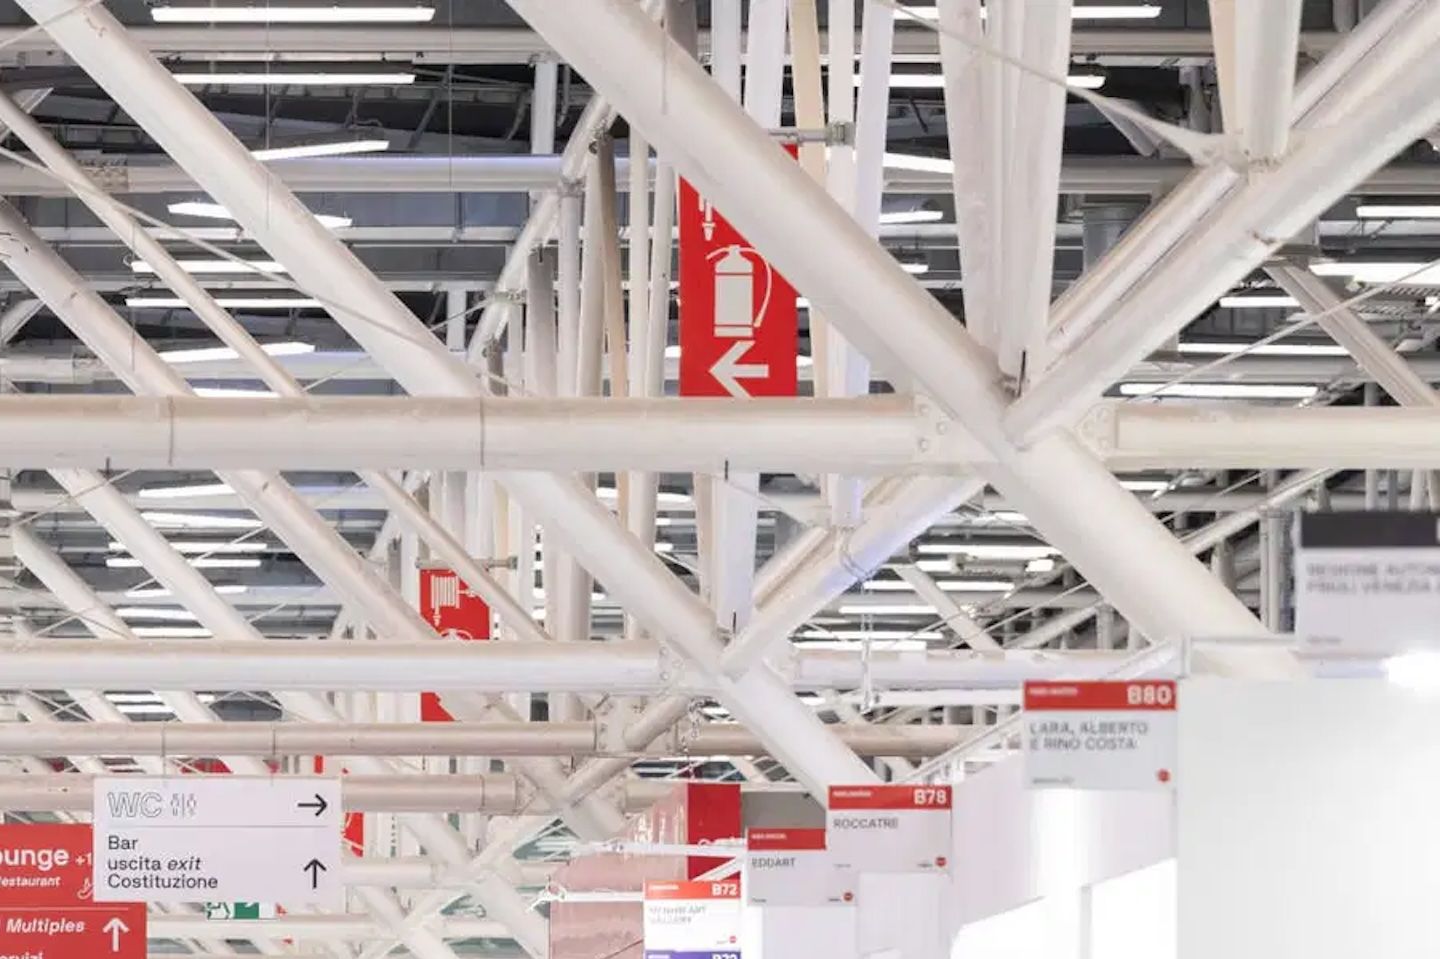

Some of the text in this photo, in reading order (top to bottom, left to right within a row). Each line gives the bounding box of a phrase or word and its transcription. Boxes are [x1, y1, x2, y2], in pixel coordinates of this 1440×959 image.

[1127, 684, 1173, 705] B80
[1080, 721, 1149, 735] ALBERTO
[1085, 737, 1138, 750] COSTA
[106, 791, 162, 818] WC
[913, 788, 947, 805] B78
[832, 817, 899, 829] ROCCATRE
[108, 835, 139, 850] Bar
[107, 855, 201, 871] uscita exit
[107, 873, 219, 889] Costituzione
[711, 883, 738, 896] B72
[6, 918, 85, 936] Multiples
